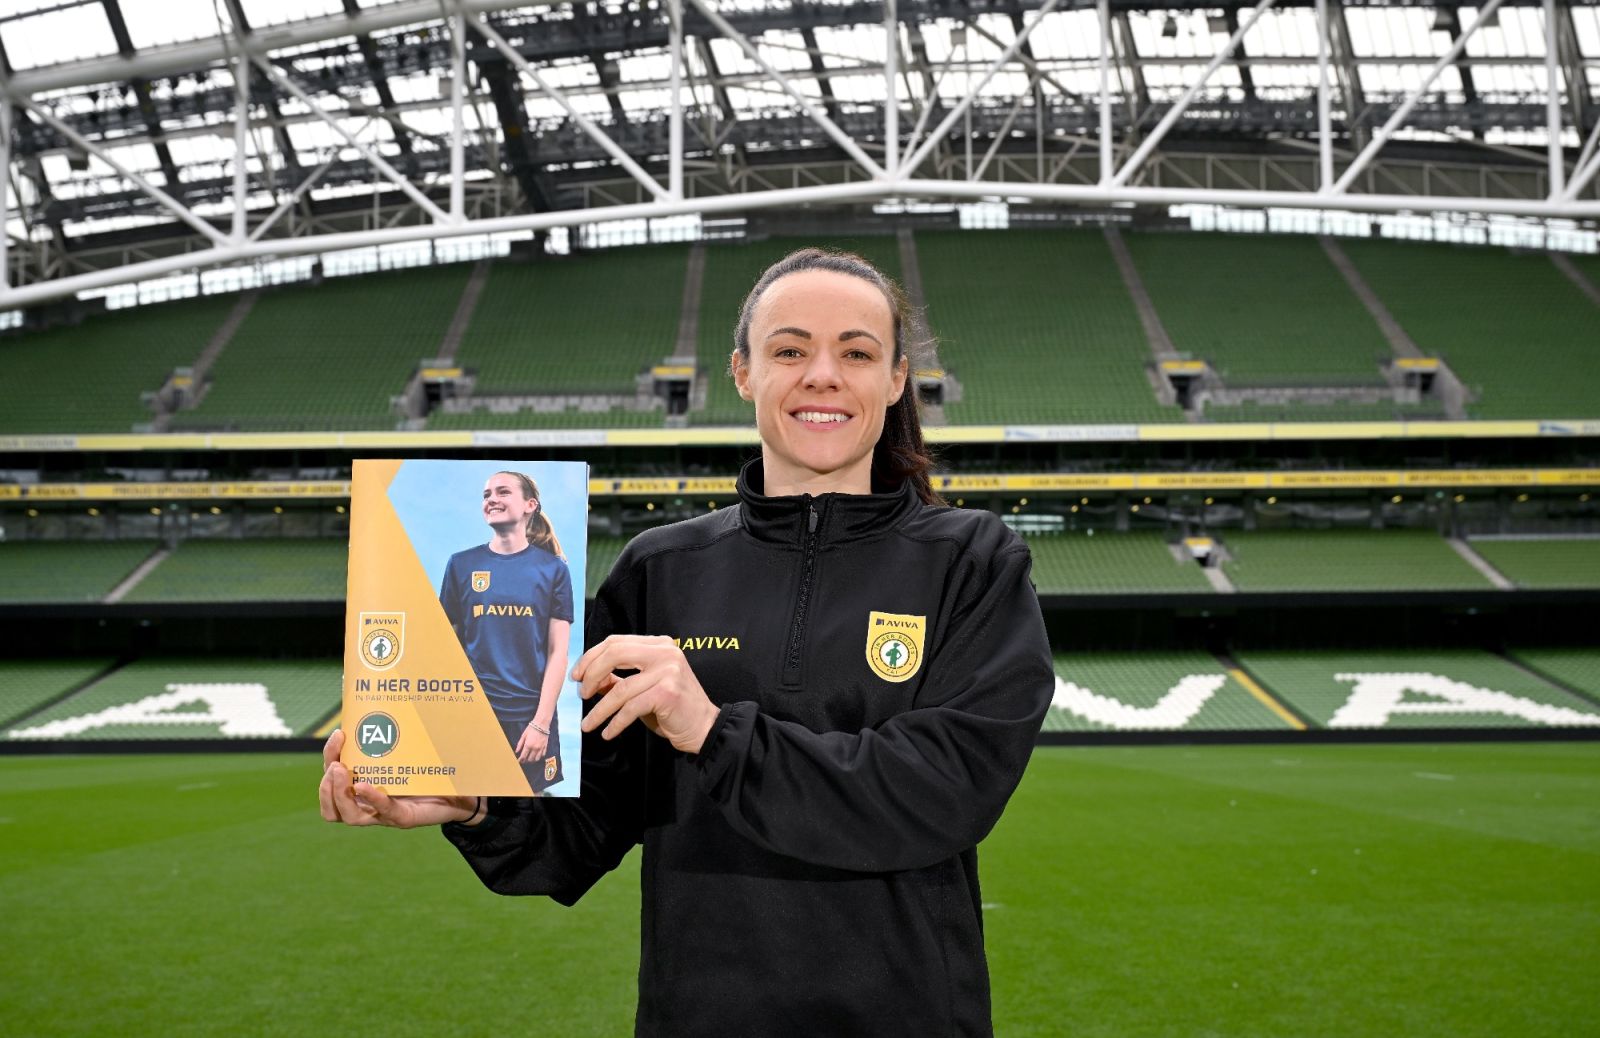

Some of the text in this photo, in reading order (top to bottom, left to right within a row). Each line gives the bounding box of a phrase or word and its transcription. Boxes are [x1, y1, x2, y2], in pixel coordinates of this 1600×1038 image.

[486, 604, 533, 617] AVIVA
[886, 620, 919, 629] AVIVA
[682, 636, 740, 650] AVIVA
[356, 679, 475, 693] IN HER BOOTS
[365, 695, 423, 703] PARTNERSHIP
[425, 695, 446, 703] WITH
[448, 695, 474, 703] AVIVA
[362, 724, 392, 744] FAI
[353, 766, 456, 775] COURSE DELIVERER
